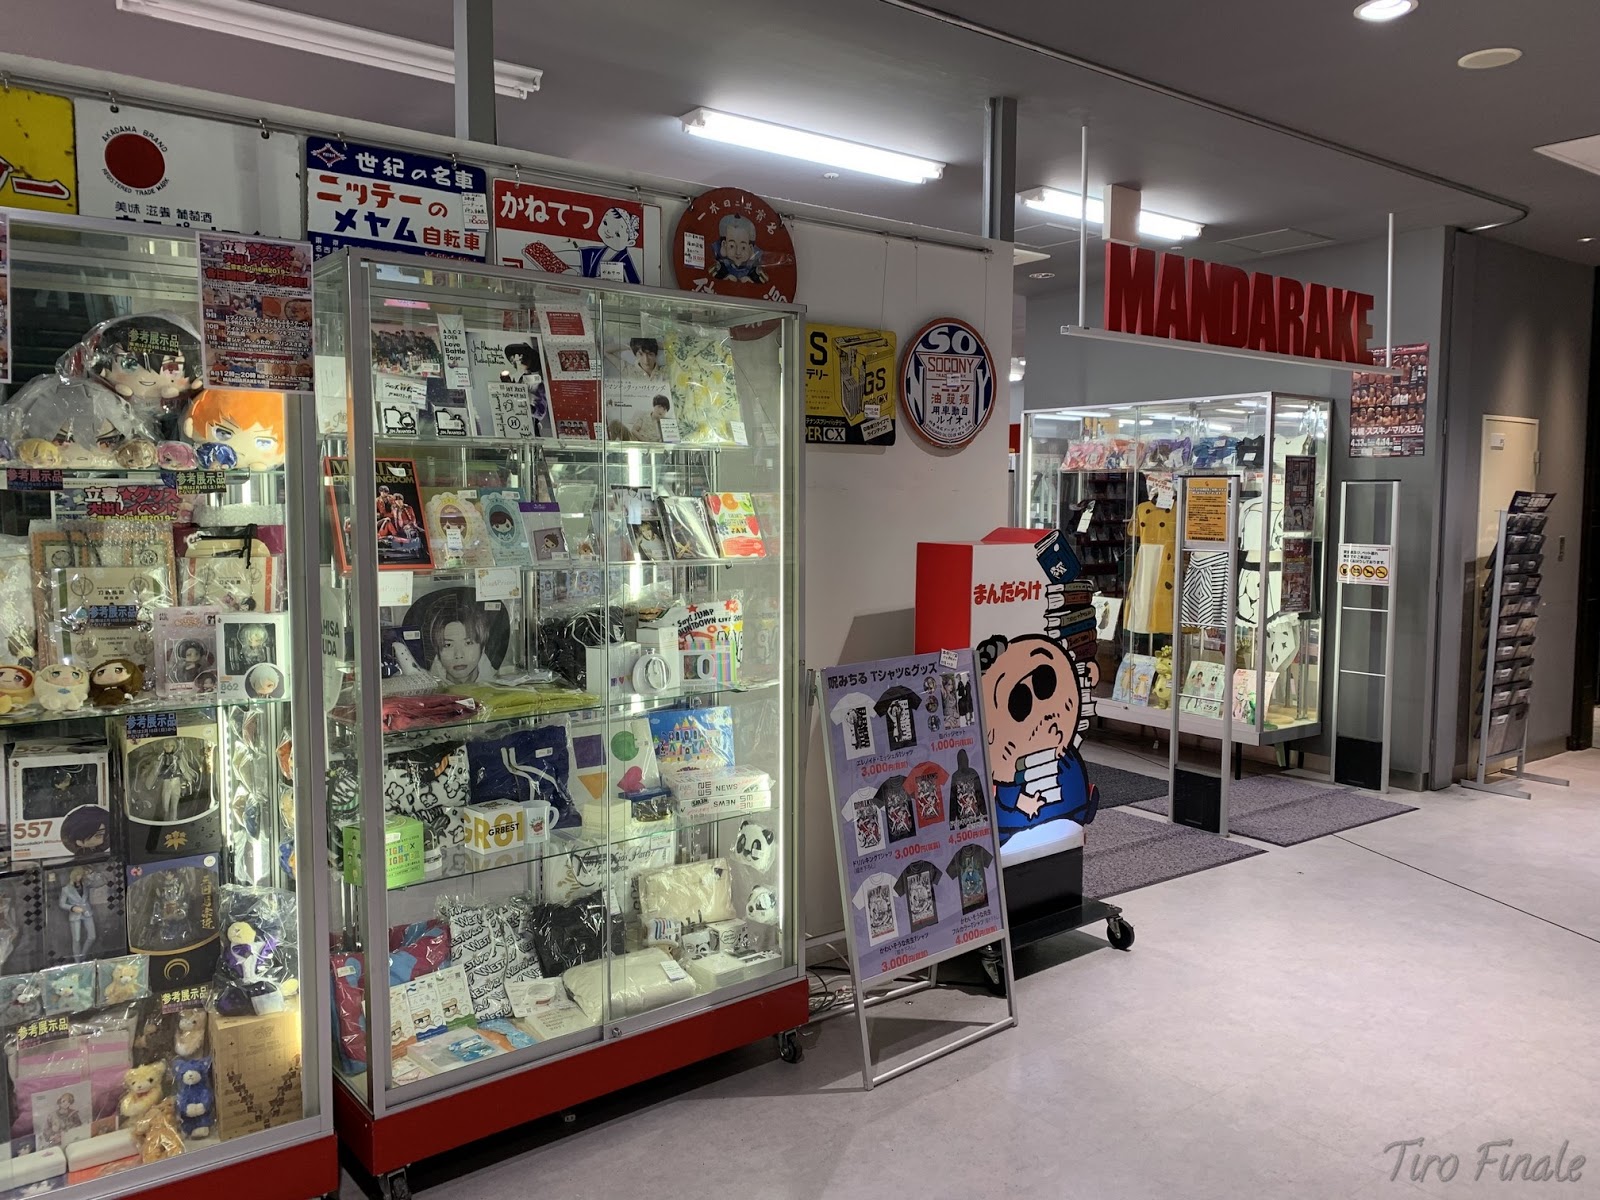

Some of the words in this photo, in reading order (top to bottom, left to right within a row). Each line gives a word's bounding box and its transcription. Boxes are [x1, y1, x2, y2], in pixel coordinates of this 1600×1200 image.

[101, 125, 137, 142] AKADAMA
[143, 130, 167, 153] BRAND
[102, 168, 132, 194] REGISTERED
[135, 188, 155, 196] TRADE
[156, 178, 169, 192] MARK
[355, 152, 474, 190] 世紀の名車
[316, 174, 448, 218] ニッテーの
[115, 201, 140, 214] 美味
[177, 208, 212, 223] 葡萄酒
[500, 191, 594, 230] かねてつ
[334, 208, 418, 243] メヤム
[423, 226, 480, 251] 自転車
[1104, 242, 1375, 366] MANDARAKE
[128, 328, 179, 349] 参考展示品
[809, 331, 828, 366] S
[927, 356, 975, 374] SOCONY
[864, 367, 886, 397] GS
[824, 427, 846, 441] CX
[176, 470, 226, 486] 参考展示品
[973, 580, 1042, 605] まんだらけ
[89, 605, 137, 619] 参考展示品
[692, 608, 715, 621] JUMP
[827, 672, 868, 689] 呪みちる
[869, 661, 938, 682] Tシャツ&グッズ
[220, 682, 240, 692] 862
[126, 713, 177, 730] 参考展示品
[715, 783, 738, 792] NEWS
[13, 820, 53, 840] 557
[488, 823, 520, 836] GR8EST
[960, 909, 992, 925] かわいそうな先生
[879, 932, 930, 955] かわいそうな先生Tシャツ
[162, 986, 209, 1005] 参考展示品
[17, 1017, 69, 1041] 参考展示品
